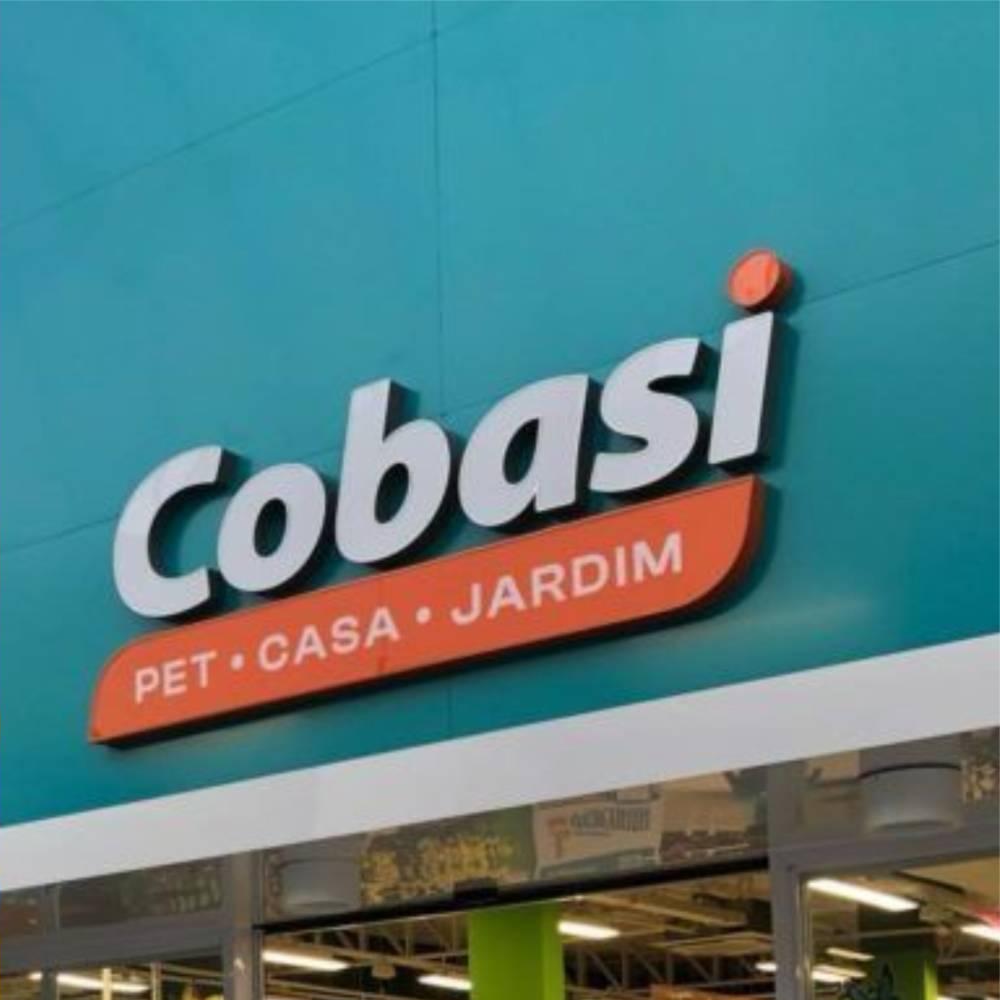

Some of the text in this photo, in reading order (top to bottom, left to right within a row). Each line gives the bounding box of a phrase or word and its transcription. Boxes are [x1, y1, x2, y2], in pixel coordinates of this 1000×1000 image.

[111, 248, 788, 621] Cobasi
[134, 531, 684, 703] PET CASA JARDIM
